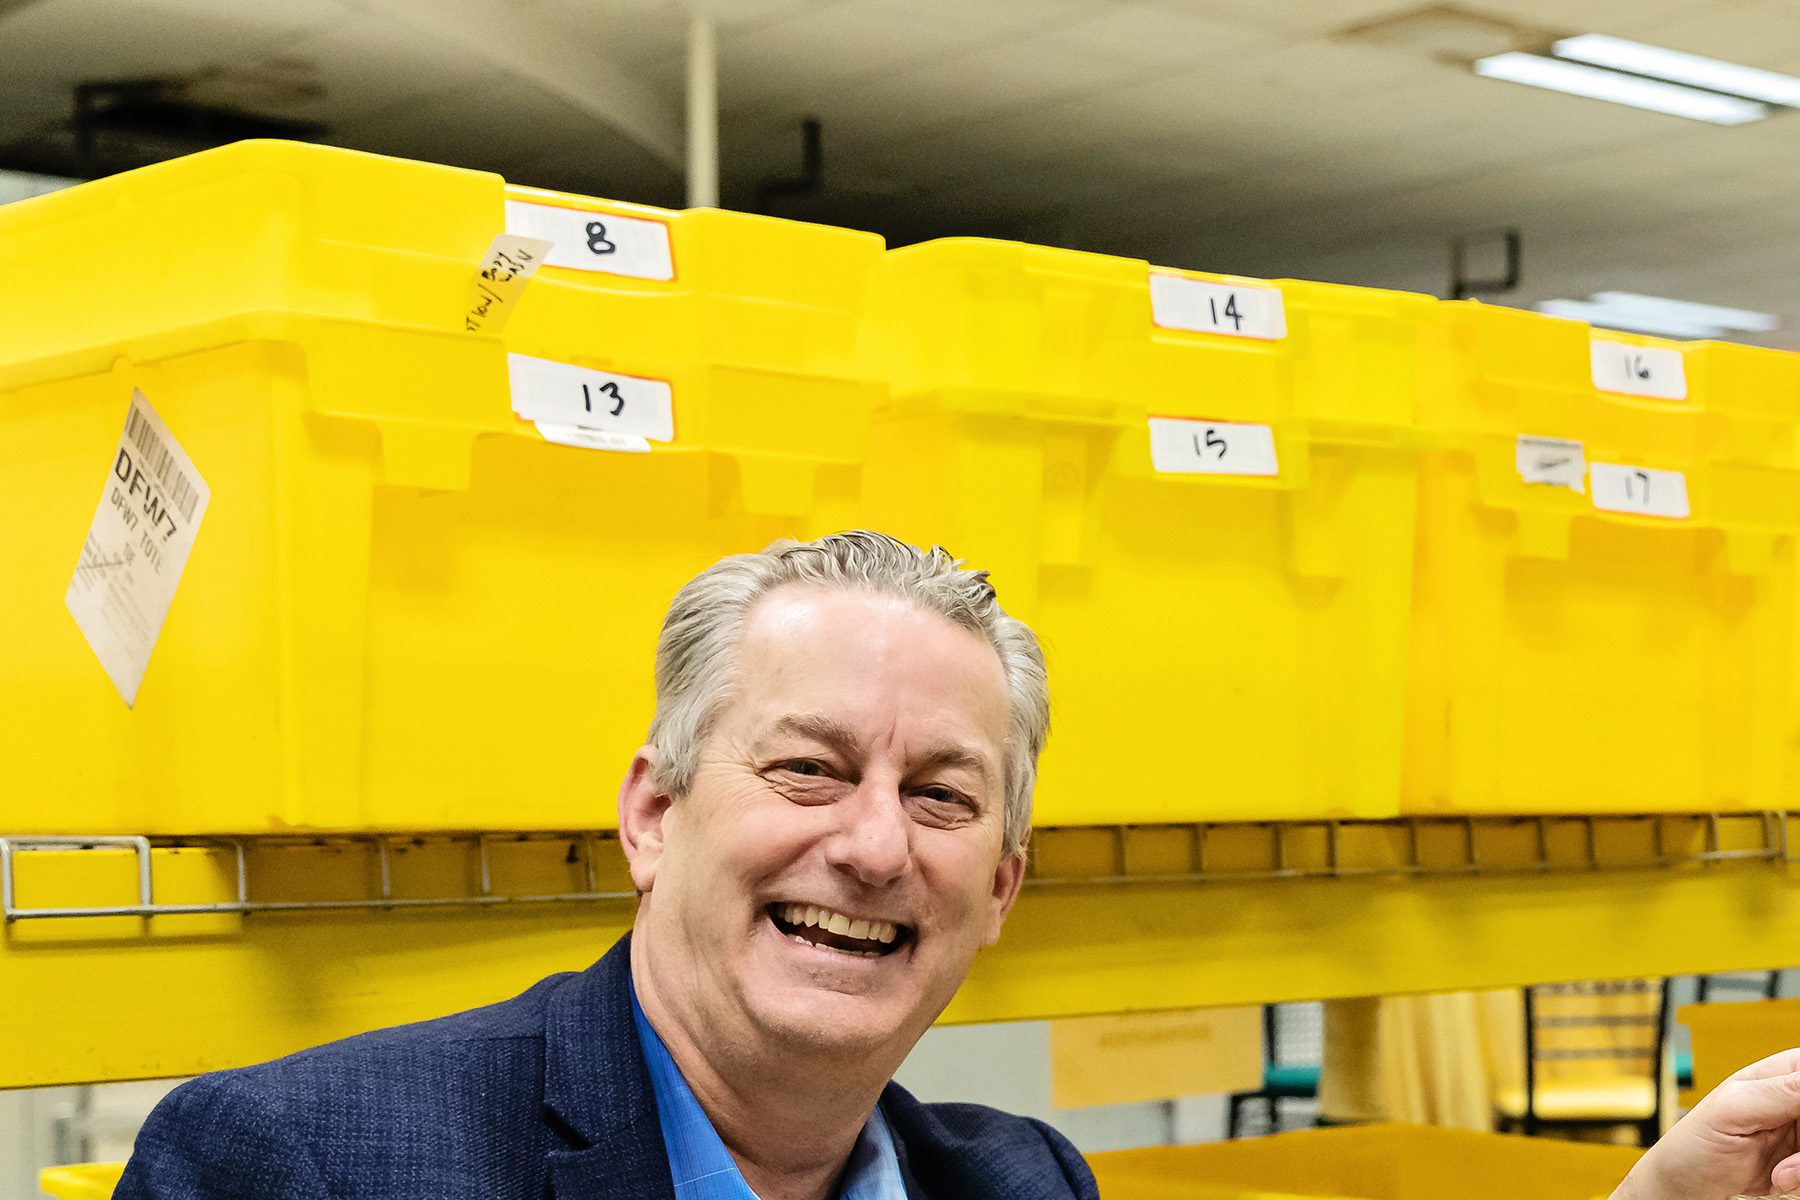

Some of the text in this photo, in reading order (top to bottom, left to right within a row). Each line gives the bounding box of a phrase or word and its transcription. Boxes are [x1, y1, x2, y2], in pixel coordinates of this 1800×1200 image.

[586, 221, 616, 255] 8
[1210, 293, 1244, 331] 14
[1624, 354, 1650, 380] 16
[583, 381, 626, 417] 13
[1194, 428, 1228, 459] 15
[115, 446, 178, 543] DFW7
[1625, 470, 1650, 505] 17
